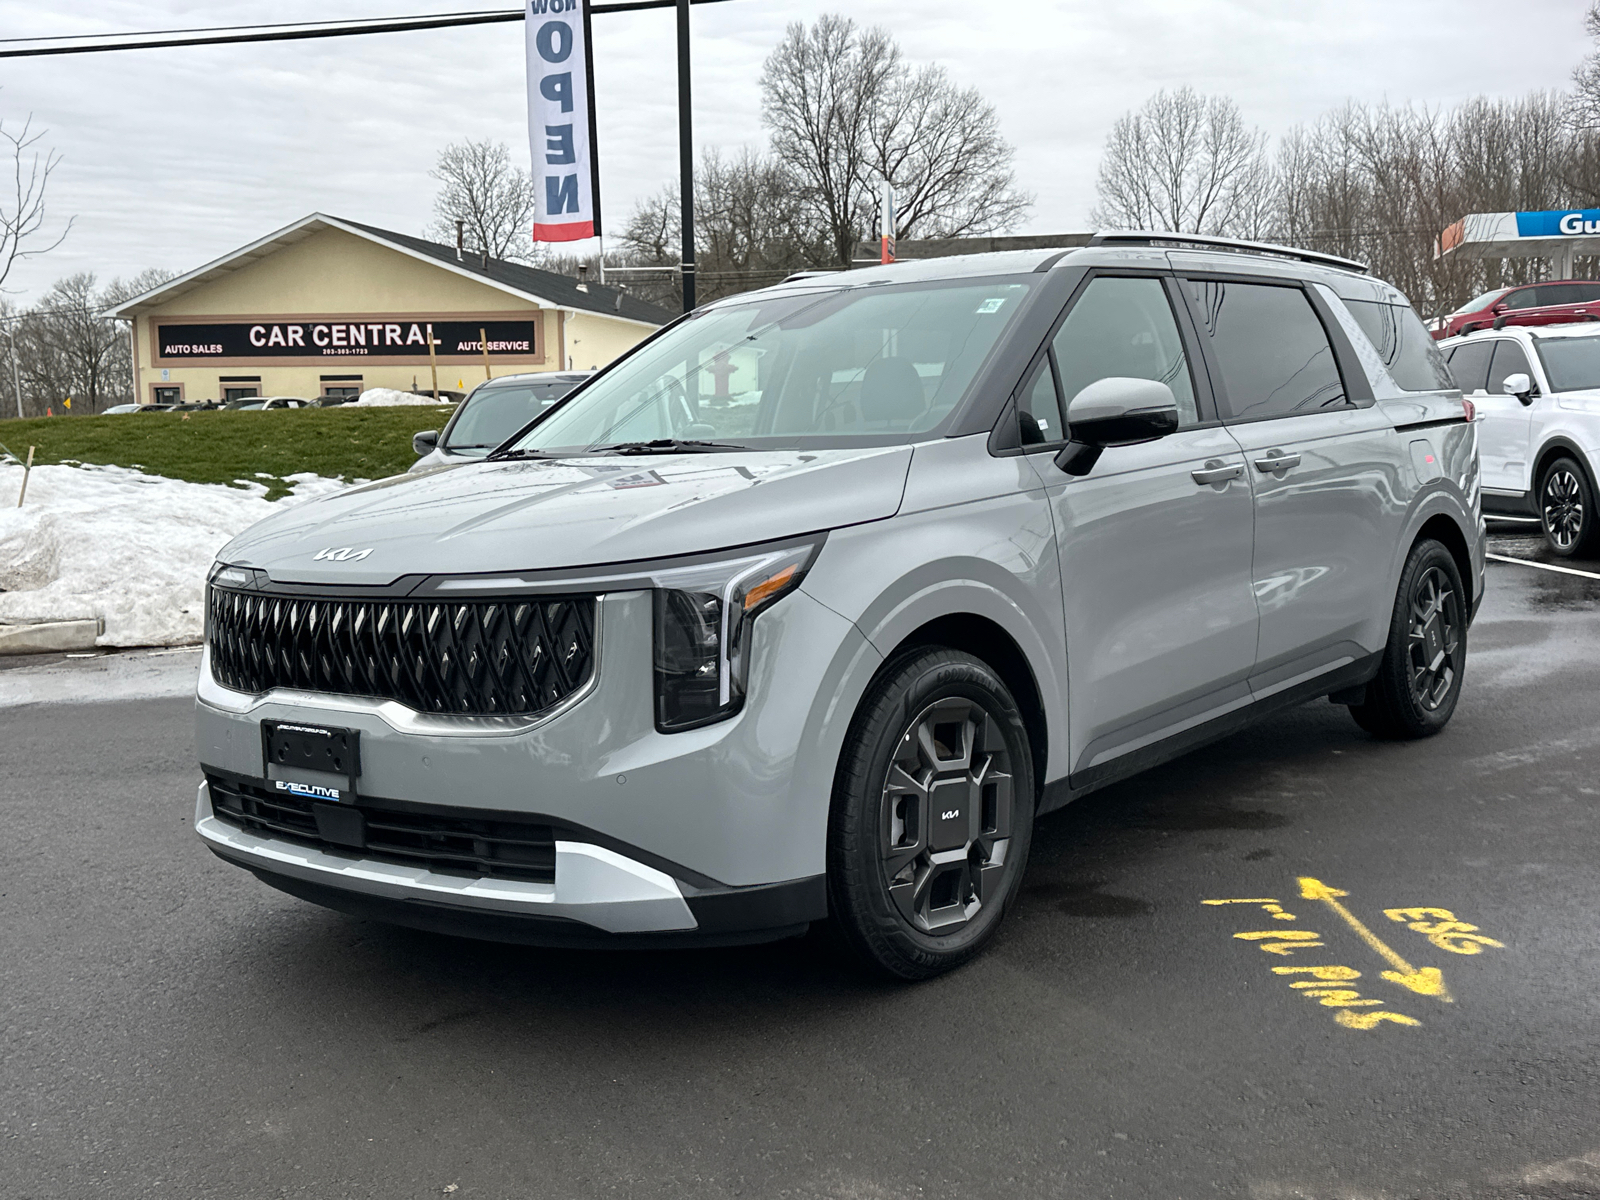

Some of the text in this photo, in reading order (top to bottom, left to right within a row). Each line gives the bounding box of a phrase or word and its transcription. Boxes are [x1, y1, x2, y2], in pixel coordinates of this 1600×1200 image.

[1560, 213, 1600, 235] Gu
[250, 323, 442, 347] CAR CENTRAL
[165, 344, 223, 354] AUTO SALES
[487, 340, 530, 351] SERVICE
[313, 547, 375, 562] KIA
[276, 780, 340, 799] EXECUTIVE
[941, 809, 960, 820] KIA
